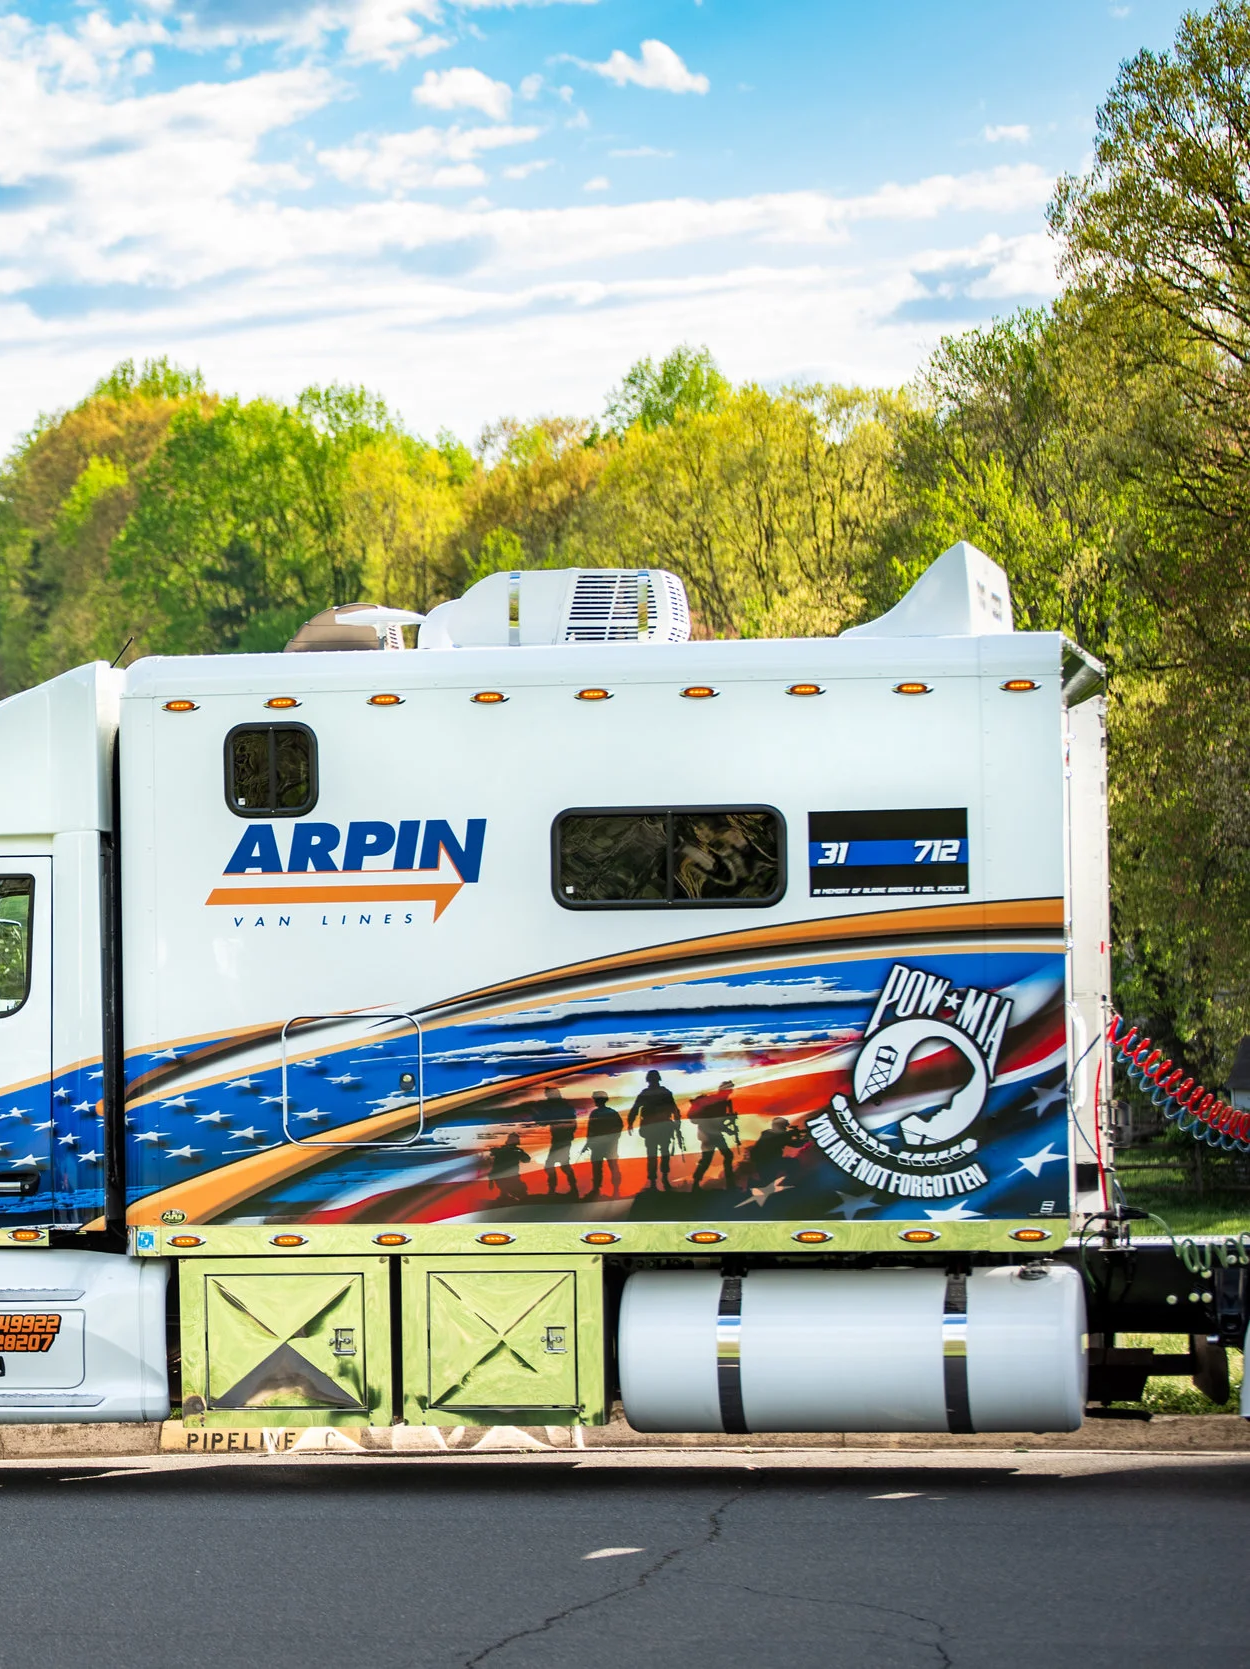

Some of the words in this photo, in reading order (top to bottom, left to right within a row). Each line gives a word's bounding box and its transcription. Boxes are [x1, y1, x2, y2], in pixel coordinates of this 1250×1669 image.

[223, 818, 487, 883] ARPIN
[817, 842, 849, 865] 31
[914, 840, 961, 862] 712
[234, 916, 291, 927] VAN
[322, 914, 412, 925] LINES
[864, 964, 951, 1038] POW
[955, 988, 1013, 1081] MIA
[806, 1113, 841, 1148] YOU
[824, 1140, 863, 1173] ARE
[852, 1158, 892, 1190] NOT
[887, 1163, 988, 1197] FORGOTTEN
[187, 1432, 296, 1450] PIPELINE
